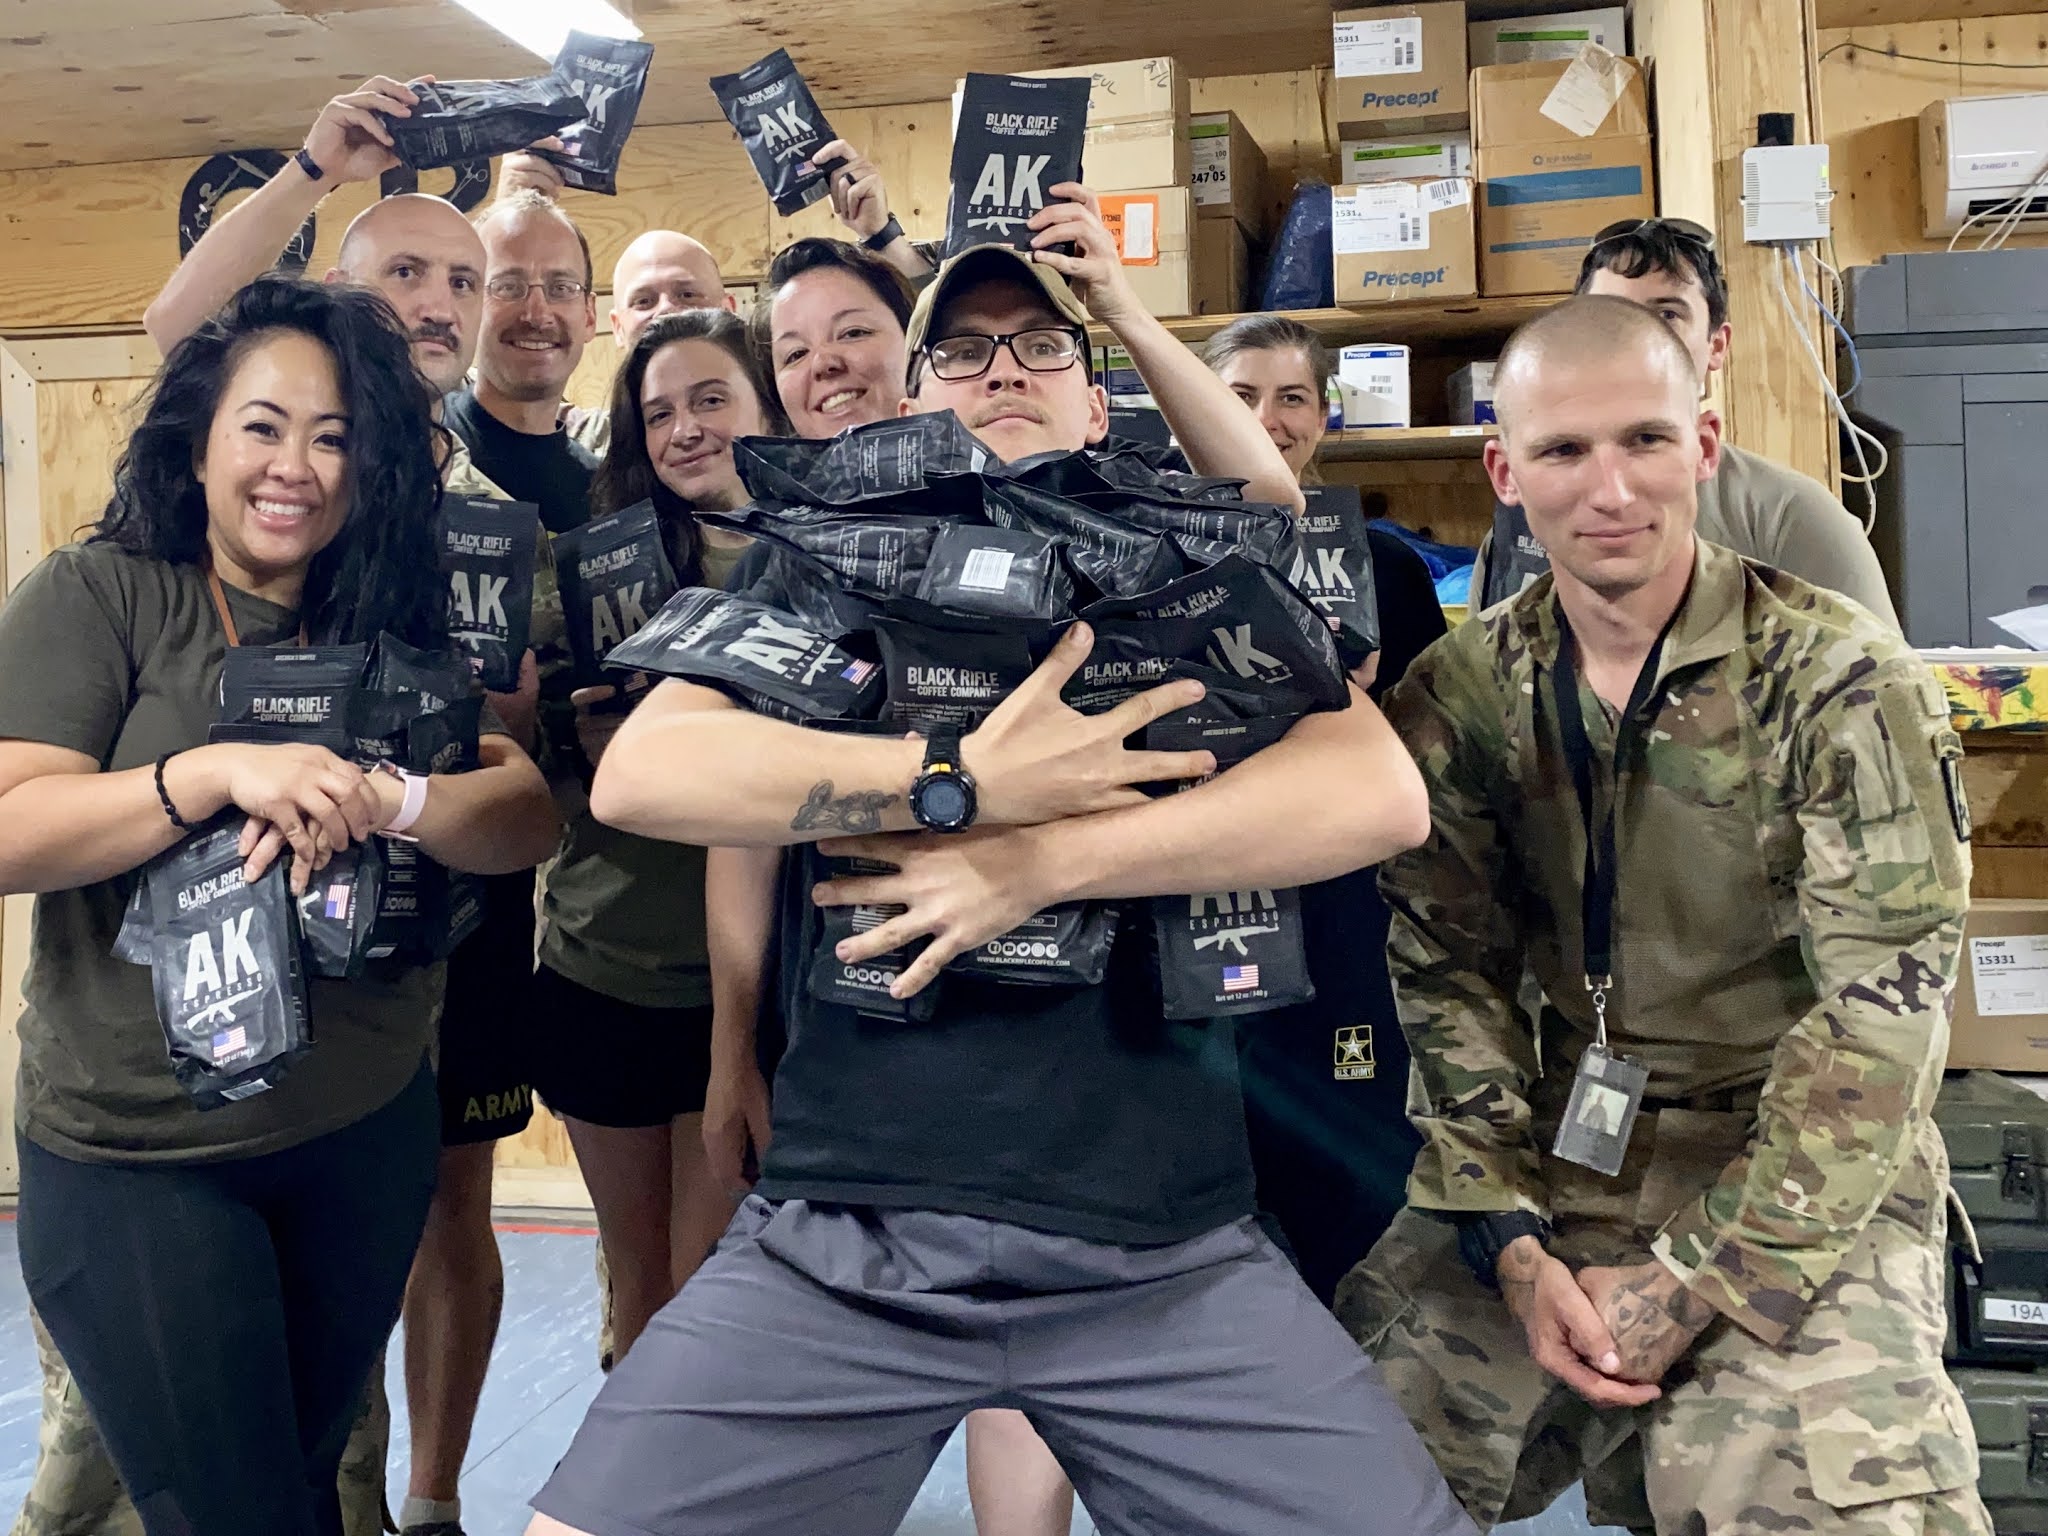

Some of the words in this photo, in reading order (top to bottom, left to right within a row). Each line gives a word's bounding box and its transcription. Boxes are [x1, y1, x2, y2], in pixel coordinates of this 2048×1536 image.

[738, 90, 763, 104] BLACK
[764, 80, 785, 95] RIFLE
[1362, 88, 1438, 108] Precept
[758, 100, 813, 148] AK
[986, 113, 1024, 128] BLACK
[1026, 115, 1058, 130] RIFLE
[992, 126, 1016, 135] COFFEE
[1018, 128, 1050, 136] COMPANY
[970, 154, 1051, 209] AK
[1213, 170, 1226, 182] 05
[967, 206, 1034, 218] ESPRESS
[1363, 267, 1445, 287] Precept
[1313, 515, 1341, 527] RIFLE
[447, 531, 480, 547] BLACK
[483, 536, 512, 550] RIFLE
[1517, 535, 1546, 551] BLAC
[579, 553, 612, 576] BLACK
[612, 543, 639, 563] RIFLE
[446, 570, 509, 628] AK
[592, 580, 650, 652] AK
[722, 614, 822, 675] AK
[784, 640, 826, 680] ESPRES
[907, 666, 956, 686] BLACK
[960, 669, 999, 687] RIFLE
[1084, 662, 1132, 680] BLACK
[917, 685, 947, 696] COFFEE
[951, 686, 991, 698] COMPANY
[253, 697, 294, 713] BLACK
[297, 696, 332, 713] RIFLE
[260, 713, 287, 722] COFFEE
[288, 713, 323, 722] COMPANY
[178, 878, 218, 909] BLACK
[220, 866, 247, 886] RIFL
[213, 881, 247, 899] COMPANY
[1189, 910, 1279, 931] ESPRESSO
[183, 907, 260, 1001] AK
[1978, 955, 2016, 965] 15331
[183, 976, 263, 1012] ESPRESSO
[1350, 1067, 1373, 1077] ARMY
[464, 1084, 529, 1123] ARMY
[2011, 1304, 2045, 1319] 19A
